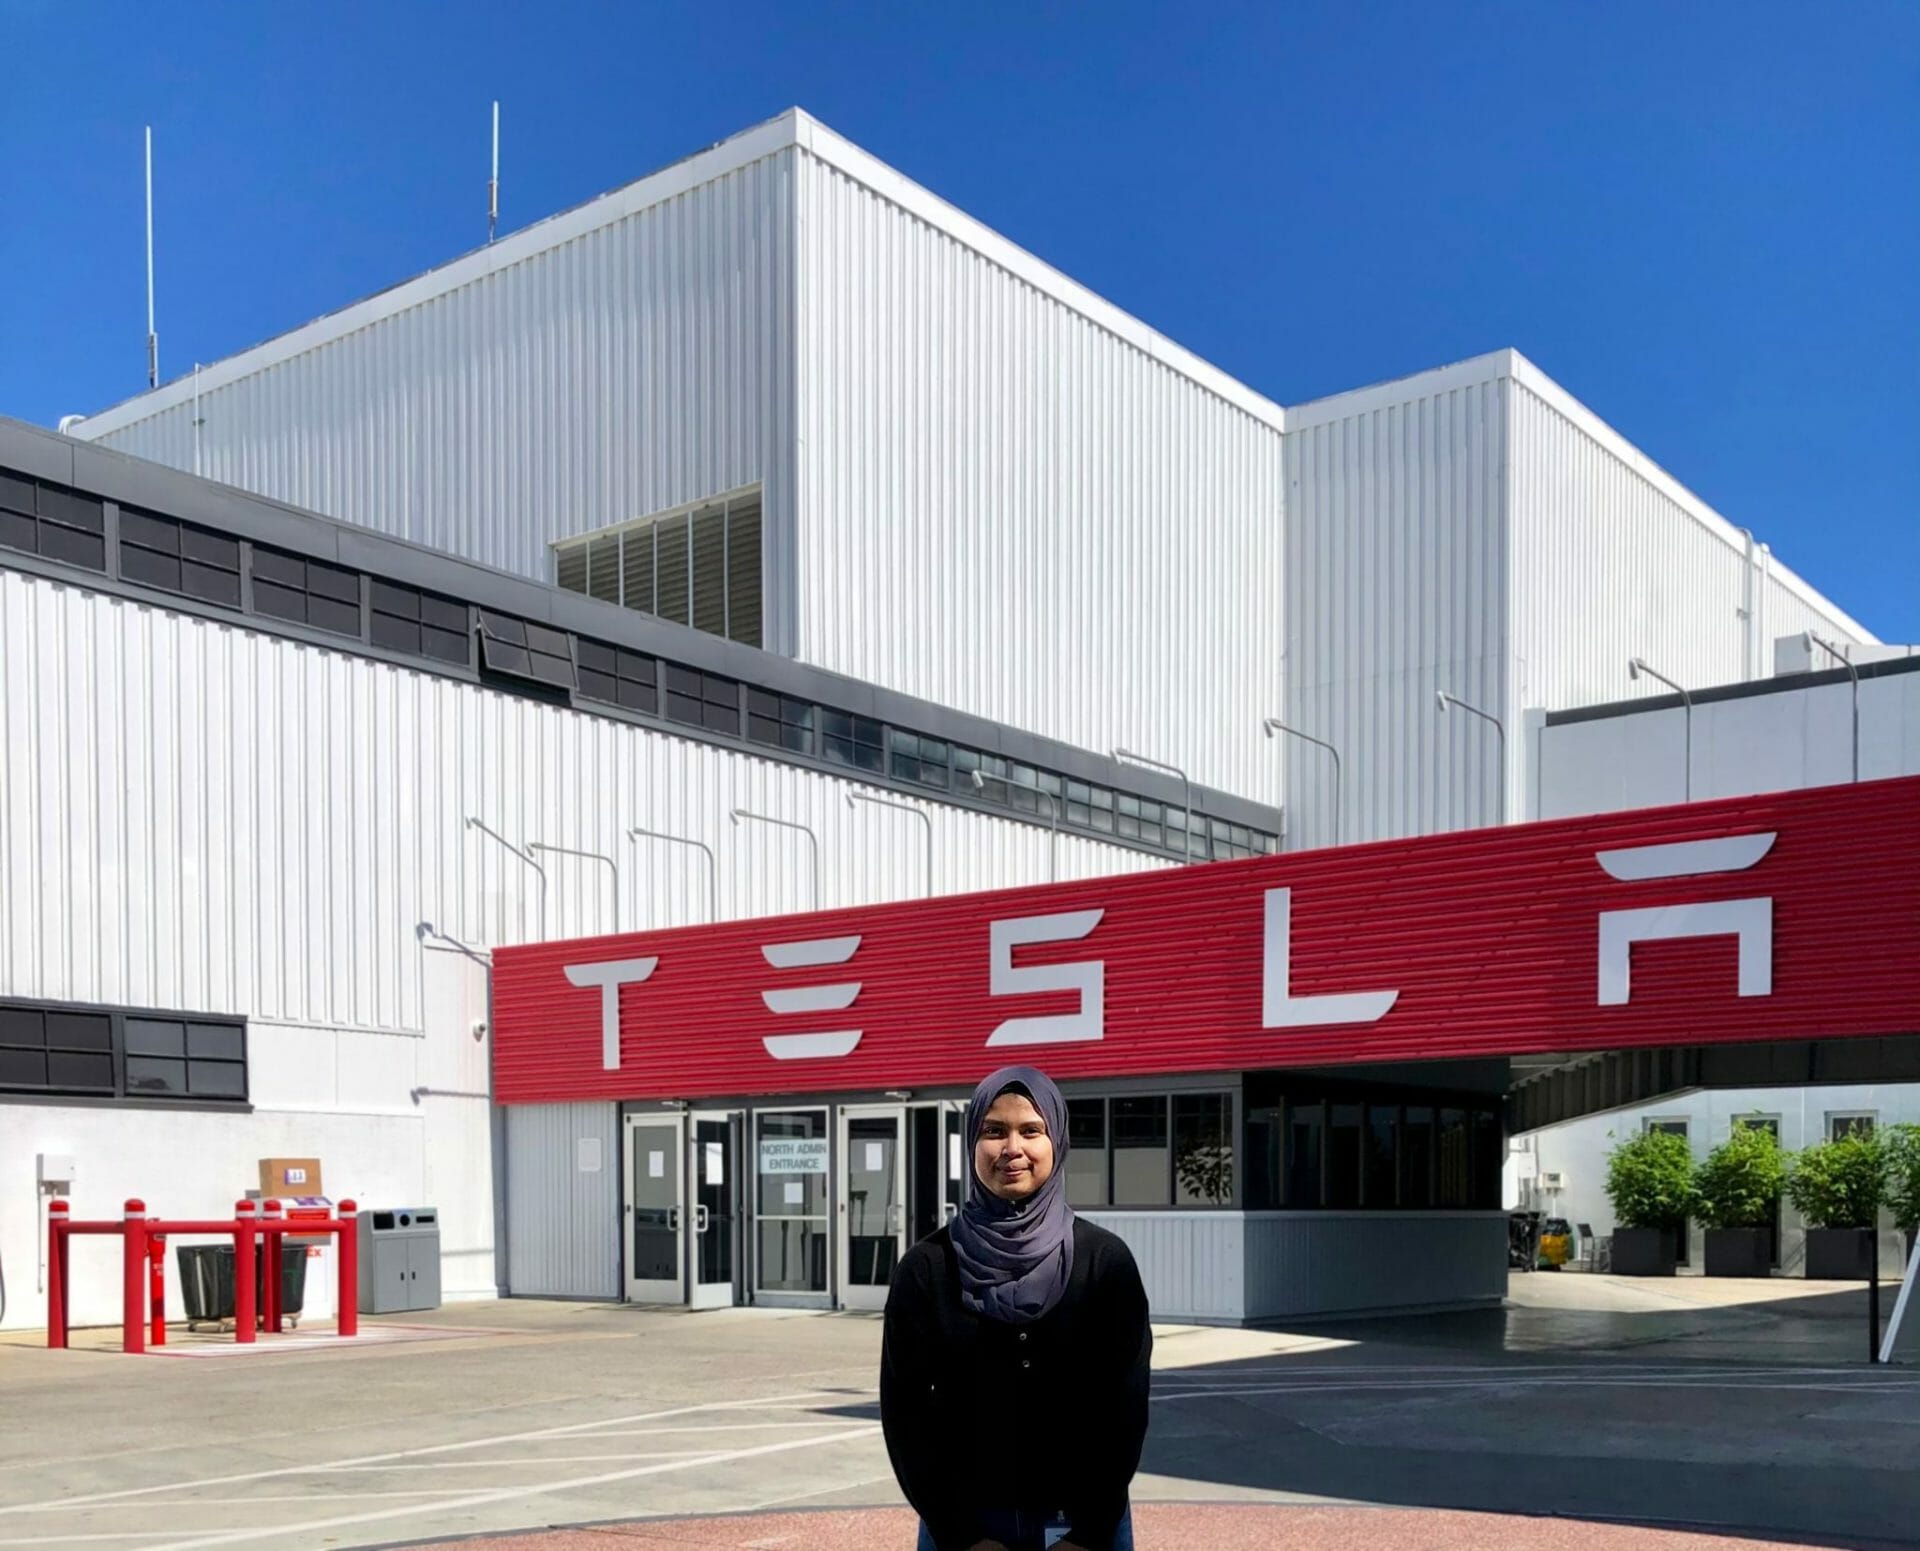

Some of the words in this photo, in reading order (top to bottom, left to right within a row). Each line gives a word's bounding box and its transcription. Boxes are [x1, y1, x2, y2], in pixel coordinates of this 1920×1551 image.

[563, 831, 1777, 1070] TESLA
[762, 1144, 794, 1155] NORTH
[797, 1143, 827, 1154] ADMIN
[769, 1158, 819, 1169] ENTRANCE
